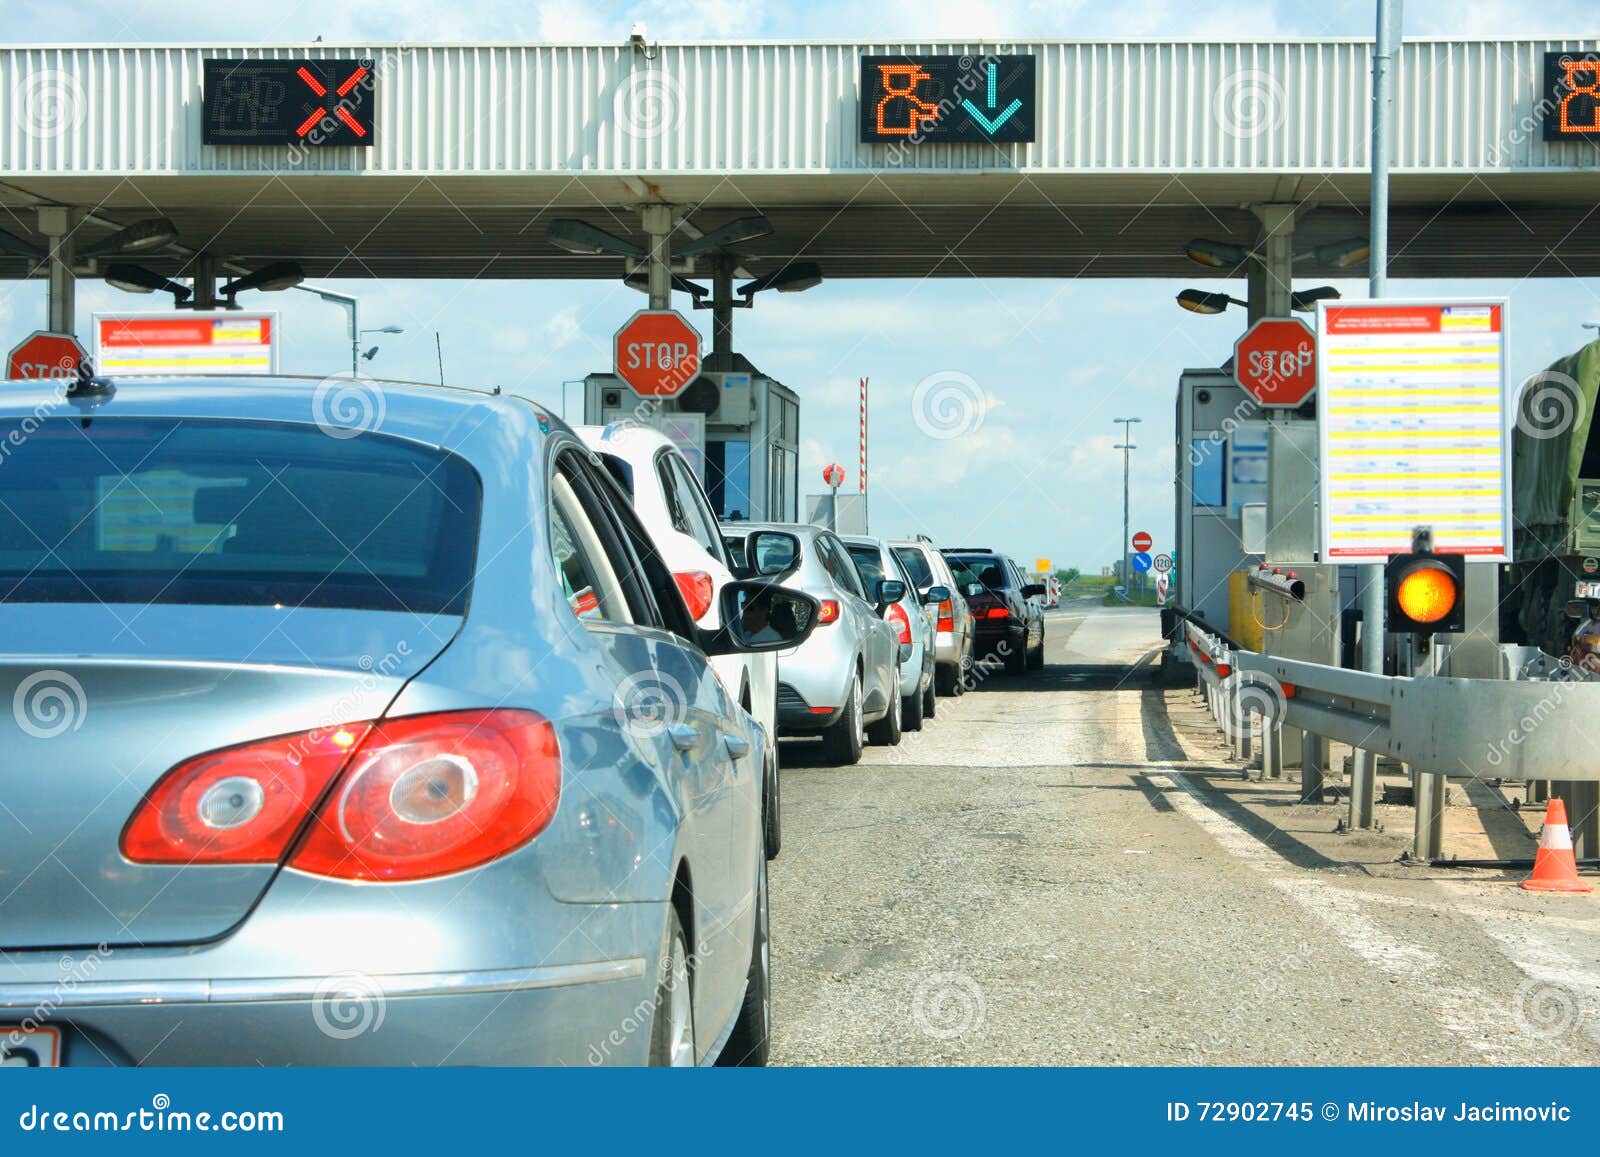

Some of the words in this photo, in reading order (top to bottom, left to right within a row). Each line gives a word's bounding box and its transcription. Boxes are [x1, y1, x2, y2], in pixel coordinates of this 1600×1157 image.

[627, 343, 689, 369] STOP
[1248, 350, 1313, 377] STOP
[1157, 558, 1170, 568] 120
